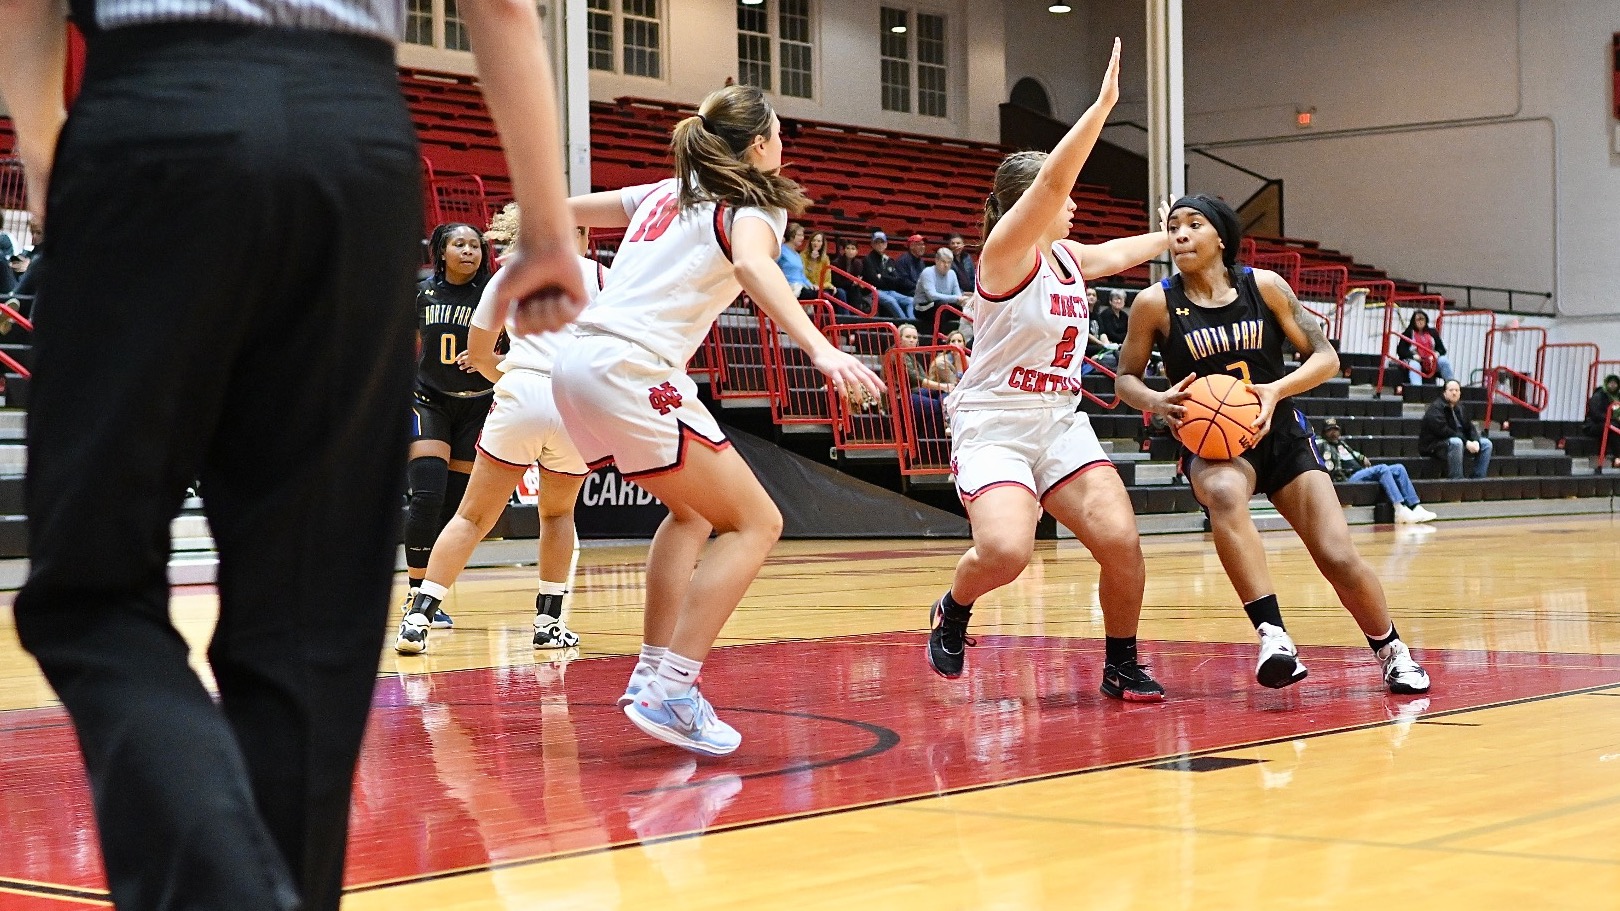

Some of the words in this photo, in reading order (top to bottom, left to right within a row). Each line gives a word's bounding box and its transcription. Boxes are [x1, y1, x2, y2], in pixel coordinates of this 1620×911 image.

[628, 191, 680, 243] 10
[425, 304, 452, 326] NORTH
[440, 333, 456, 365] 0
[1050, 325, 1079, 369] 2
[1184, 325, 1230, 361] NORTH
[1232, 319, 1264, 351] PARK
